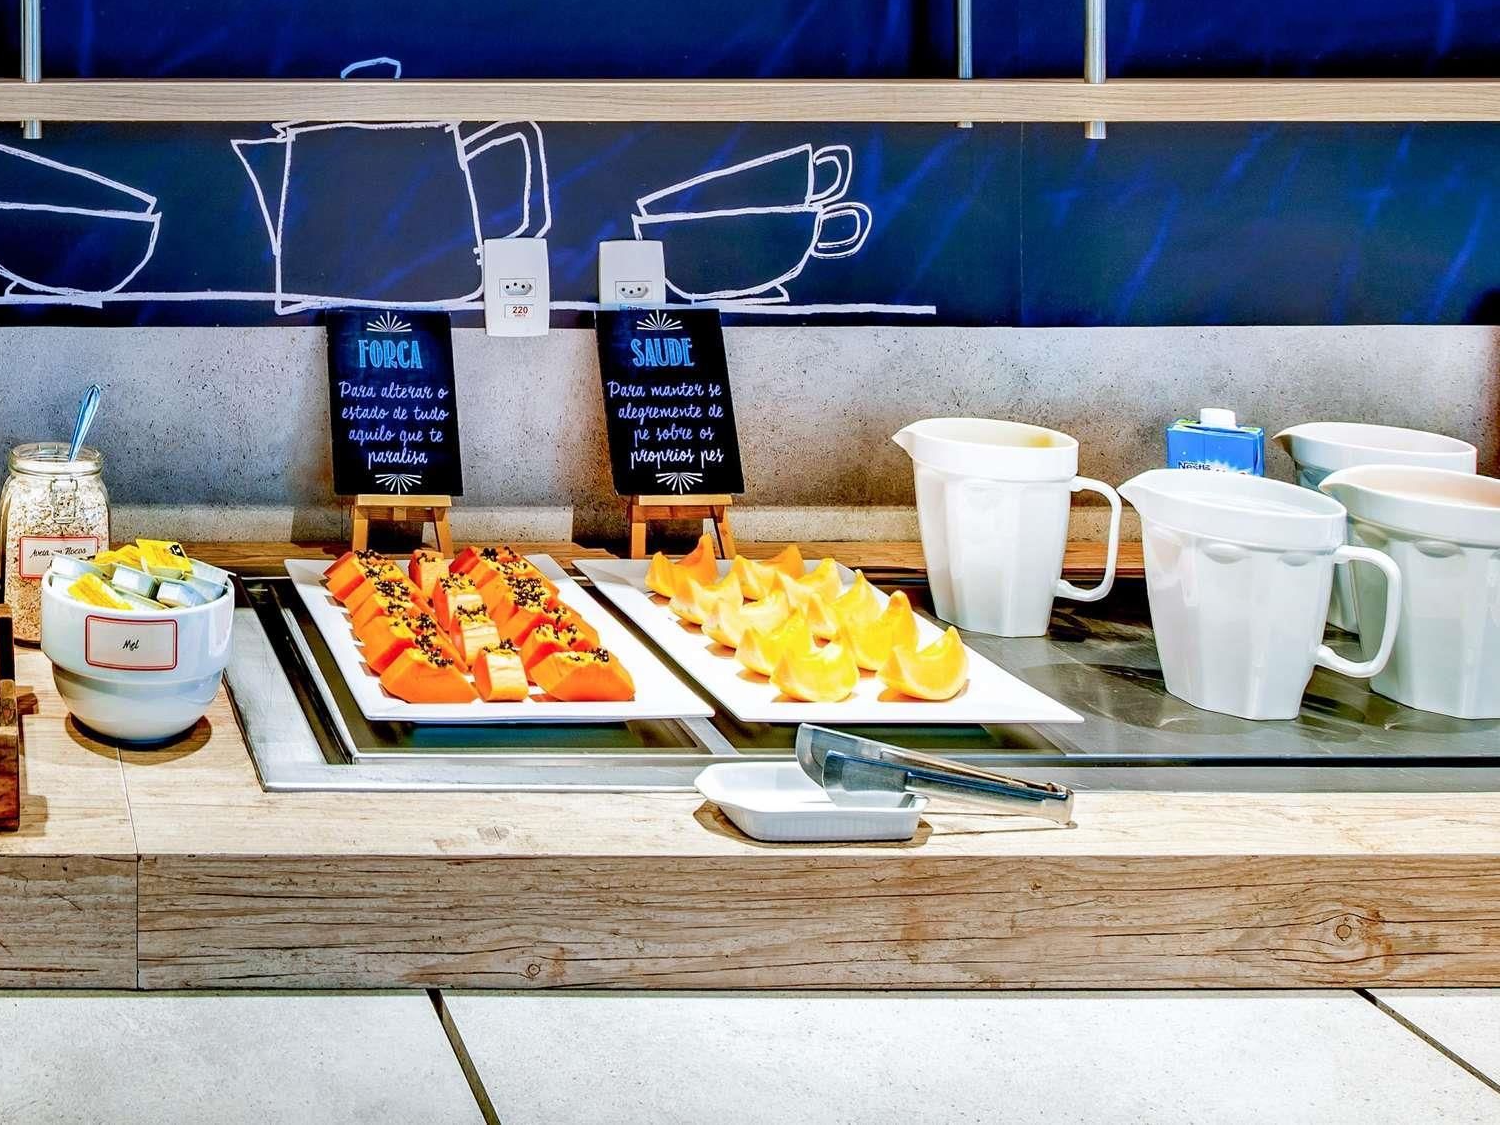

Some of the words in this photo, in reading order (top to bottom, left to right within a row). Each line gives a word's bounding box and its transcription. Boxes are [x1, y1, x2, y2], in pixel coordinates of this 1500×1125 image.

[512, 306, 529, 315] 220
[358, 339, 423, 369] FORCA
[630, 338, 695, 367] SAUDE
[338, 380, 377, 398] Para
[381, 382, 434, 399] alterar
[437, 387, 449, 399] o
[606, 380, 646, 398] Para
[650, 382, 705, 397] manter
[708, 383, 723, 398] se
[341, 405, 390, 420] estado
[392, 406, 408, 420] de
[413, 406, 450, 421] tudo
[618, 402, 703, 426] alegremente
[708, 404, 725, 419] de
[348, 425, 396, 447] aquilo
[399, 430, 424, 447] que
[429, 428, 444, 443] te
[634, 428, 651, 448] pe
[655, 423, 694, 442] sobre
[699, 427, 716, 441] os
[368, 447, 429, 471] paralisa
[630, 448, 695, 470] proprios
[700, 448, 725, 469] pes
[122, 639, 140, 651] Mel
